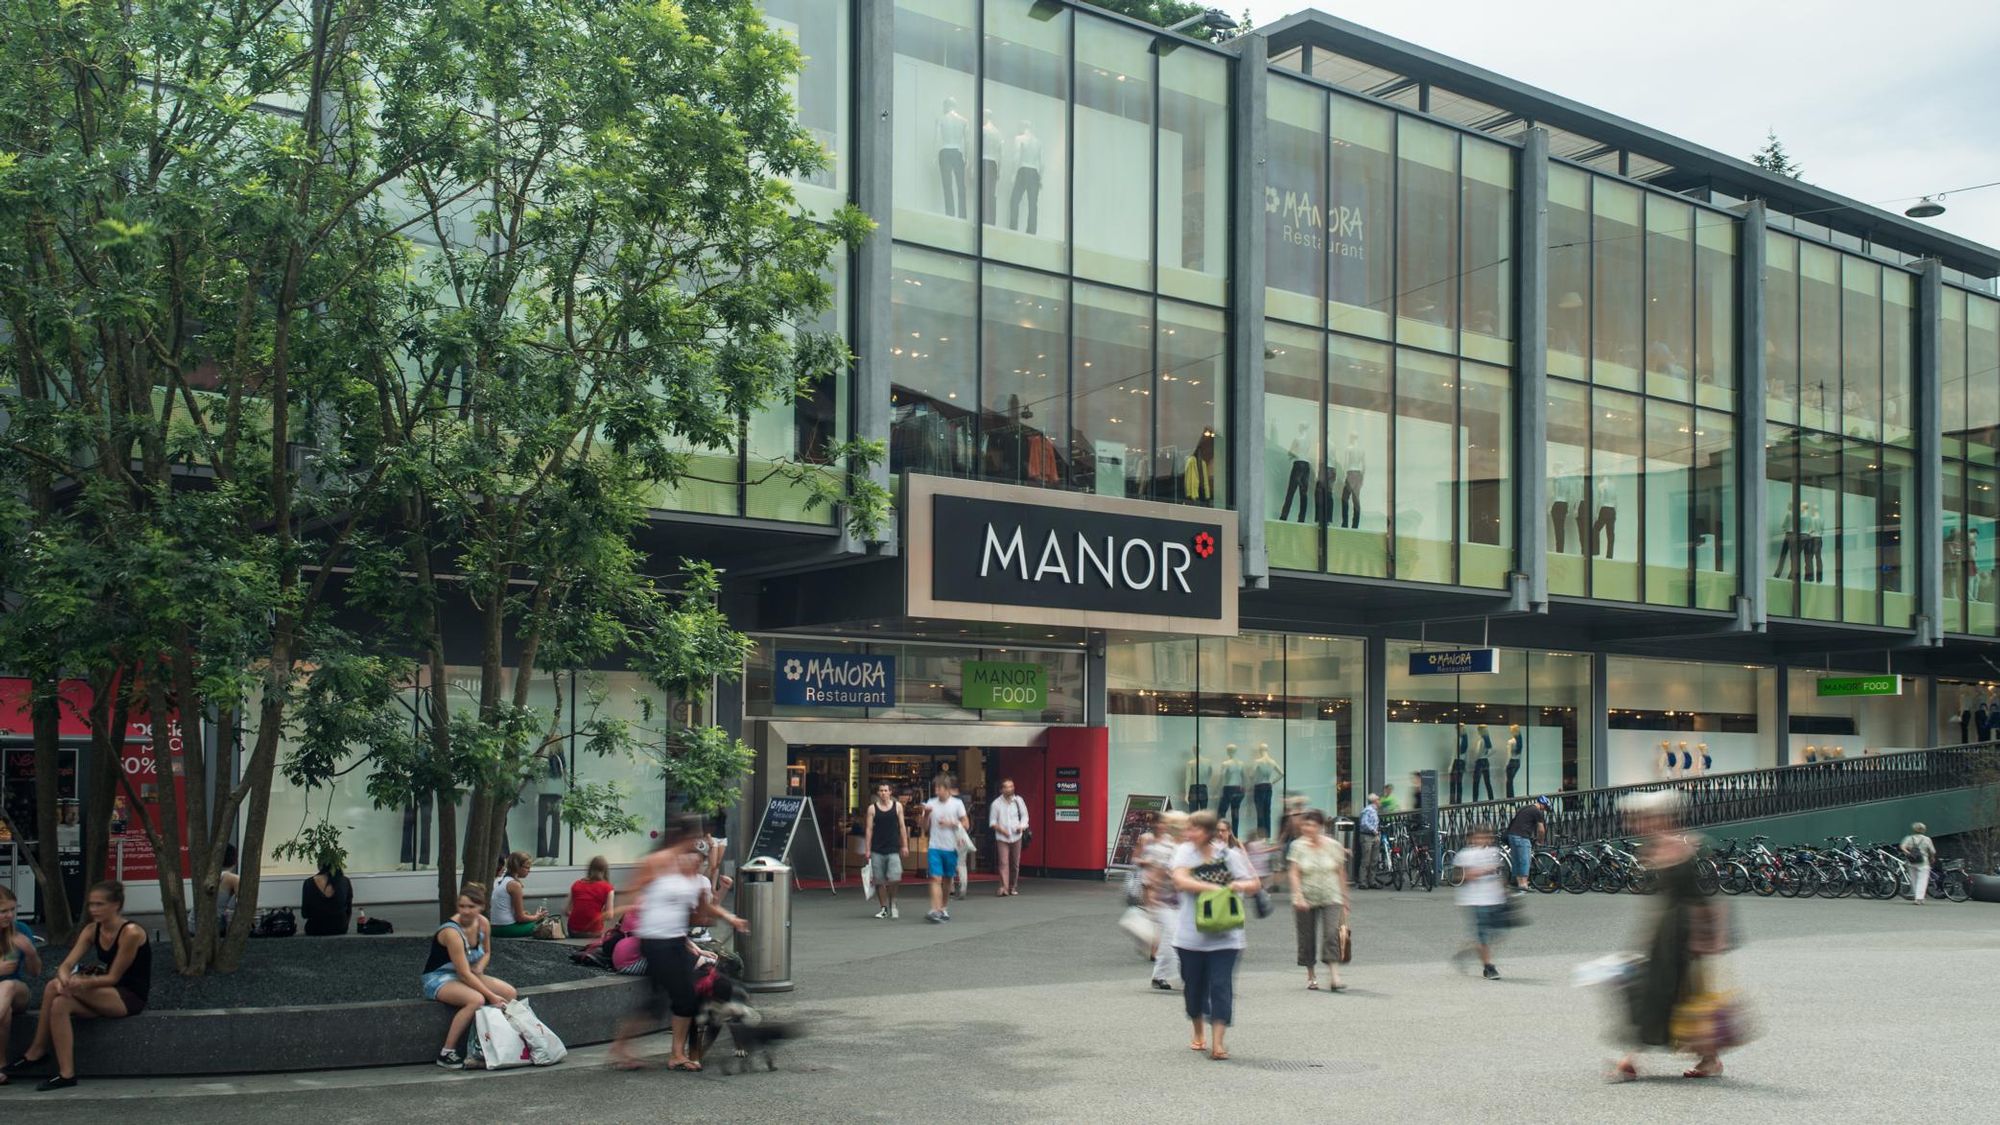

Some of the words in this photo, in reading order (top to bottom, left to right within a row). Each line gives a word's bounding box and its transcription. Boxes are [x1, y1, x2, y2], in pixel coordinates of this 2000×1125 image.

[980, 522, 1192, 593] MANOR
[1437, 652, 1472, 666] MANORA
[806, 657, 885, 688] MANORA
[974, 669, 1036, 685] MANOR
[993, 686, 1037, 703] FOOD
[1824, 683, 1857, 691] MANOR
[1863, 682, 1889, 690] FOOD
[806, 687, 886, 703] Restaurant
